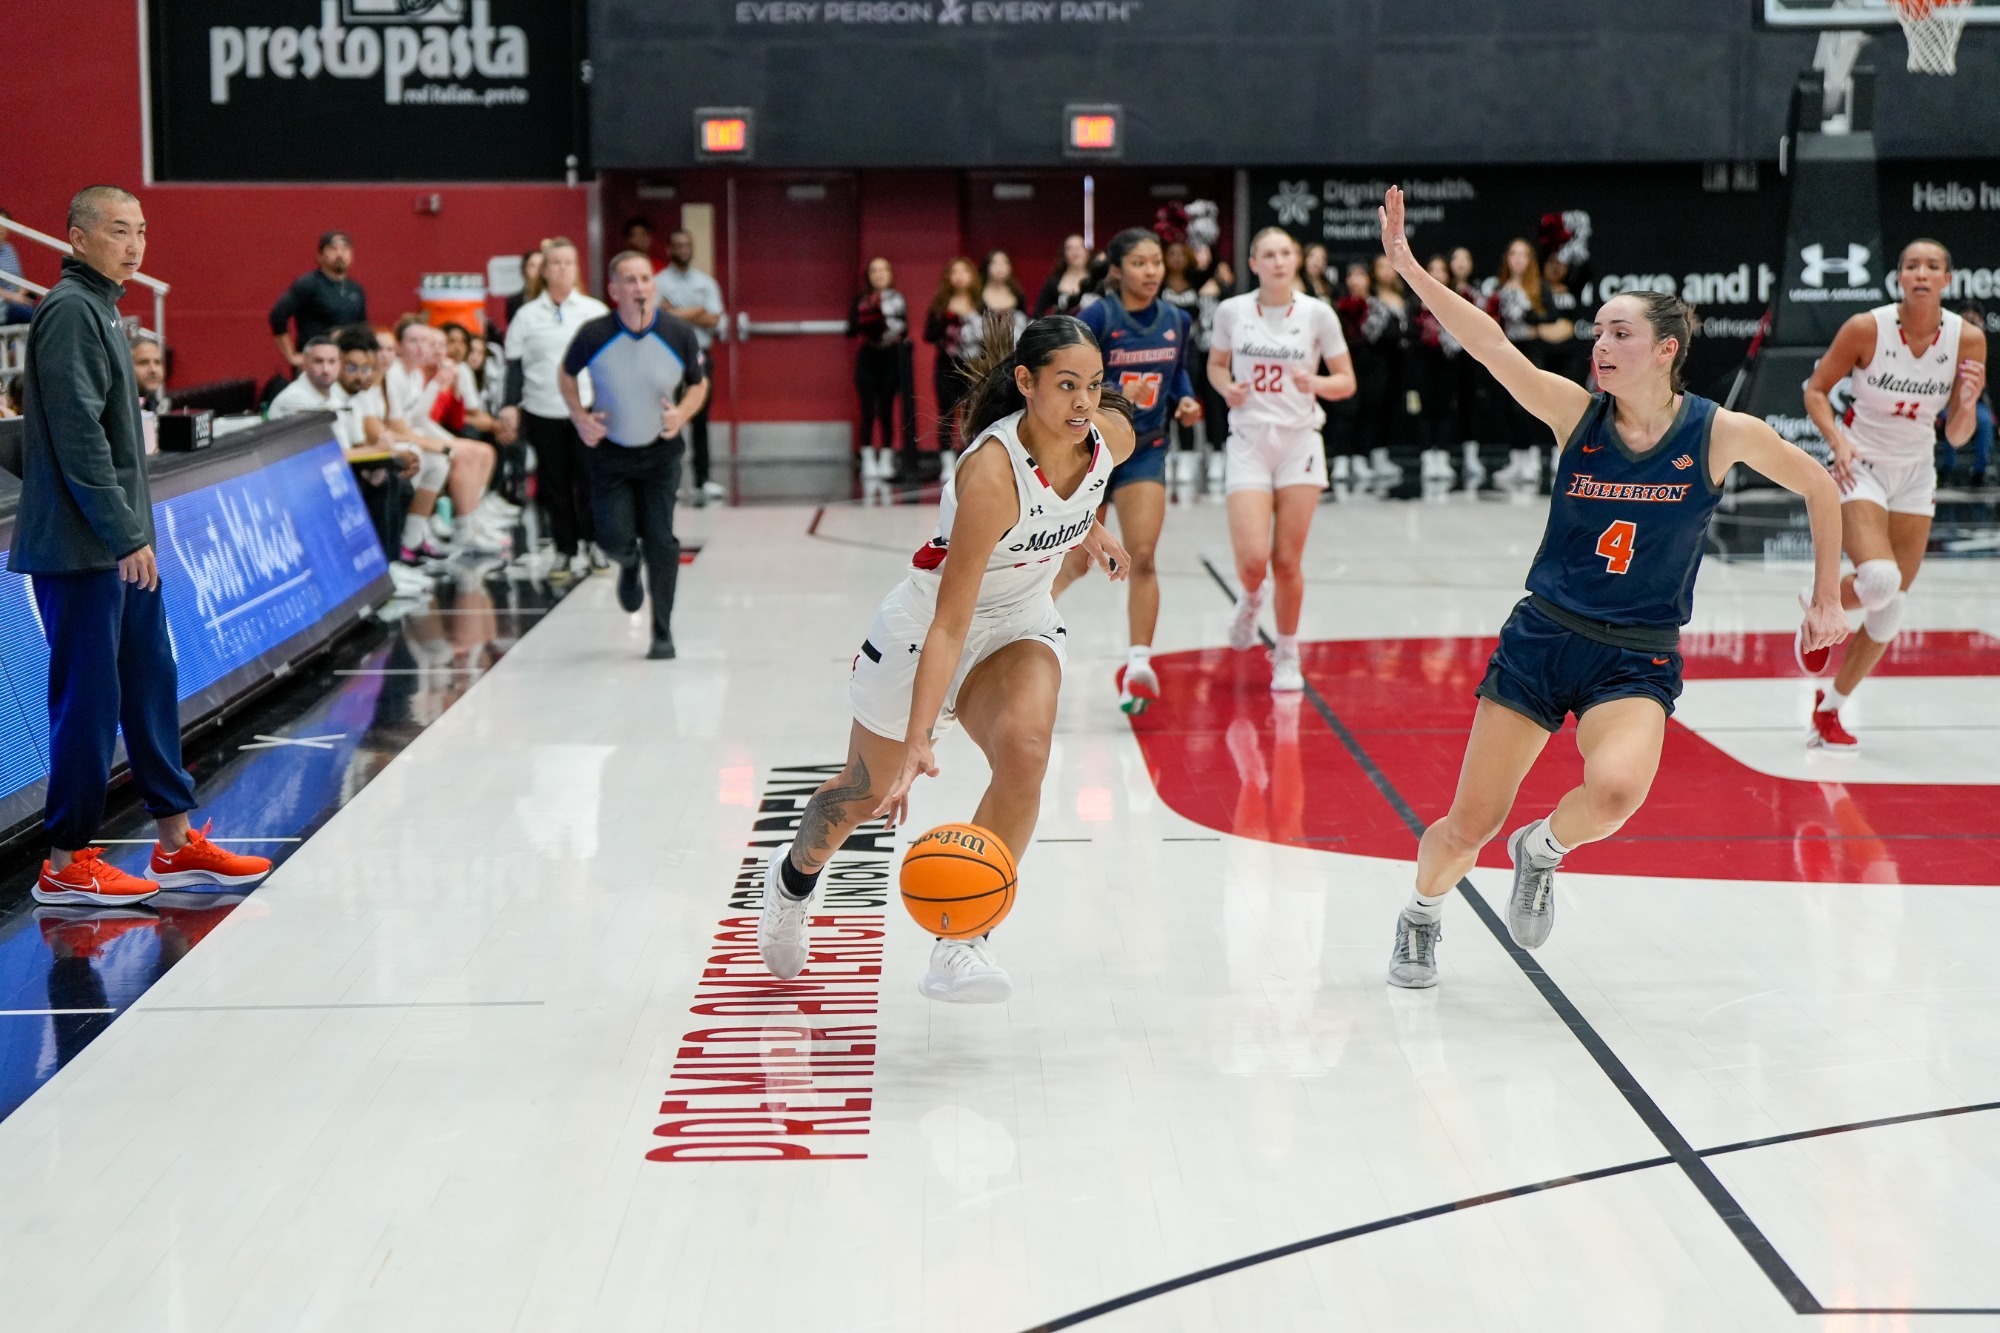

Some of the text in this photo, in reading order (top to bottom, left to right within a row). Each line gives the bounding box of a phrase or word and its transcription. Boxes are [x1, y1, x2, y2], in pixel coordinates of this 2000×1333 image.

[736, 2, 819, 23] EVERY
[824, 2, 932, 23] PERSON
[972, 2, 1053, 23] EVERY
[1323, 179, 1388, 206] Dignit
[1912, 181, 1976, 212] Hello
[1681, 263, 1751, 304] and
[1254, 364, 1283, 392] 22
[1890, 401, 1920, 420] 11
[1570, 474, 1688, 501] FULLERTON
[1008, 509, 1096, 552] Matado
[1595, 519, 1637, 575] 4
[822, 860, 890, 908] UNION
[645, 1024, 878, 1163] PREMIER
